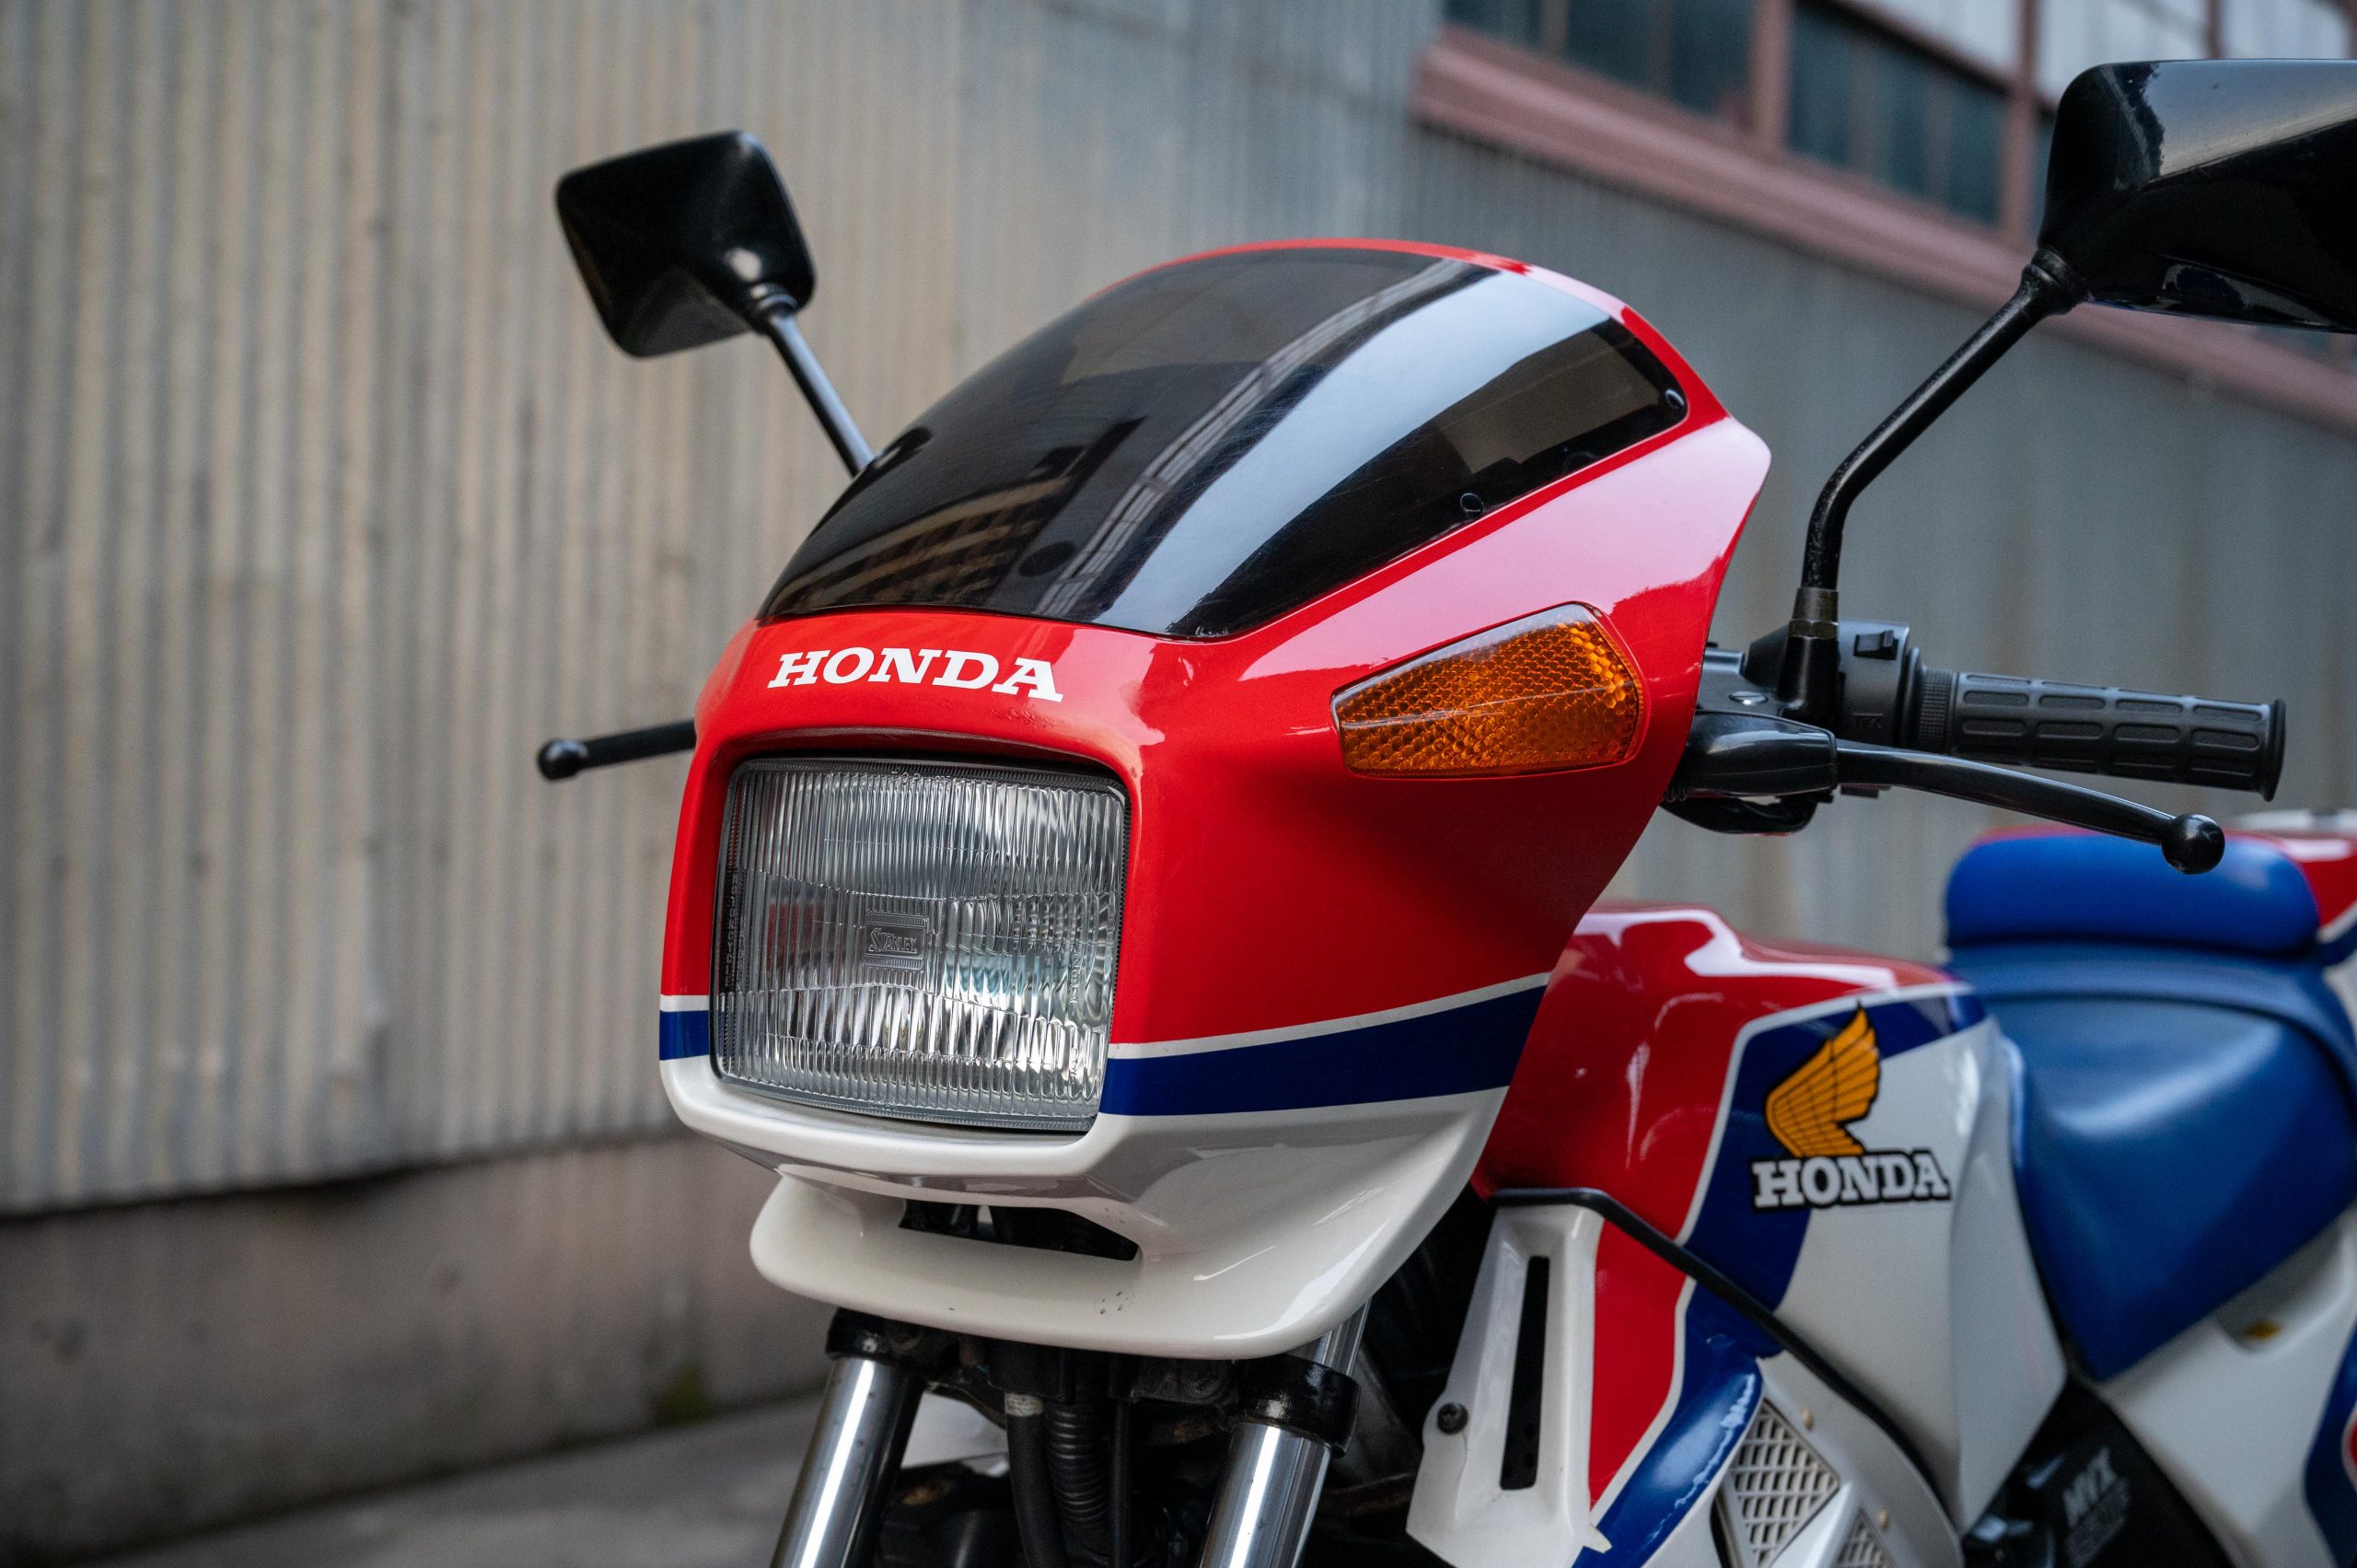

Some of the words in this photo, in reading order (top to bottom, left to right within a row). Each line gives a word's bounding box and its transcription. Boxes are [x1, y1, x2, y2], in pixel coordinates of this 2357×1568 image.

[767, 646, 1064, 703] HONDA
[868, 927, 918, 954] STANLEY
[1750, 1151, 1950, 1211] HONDA
